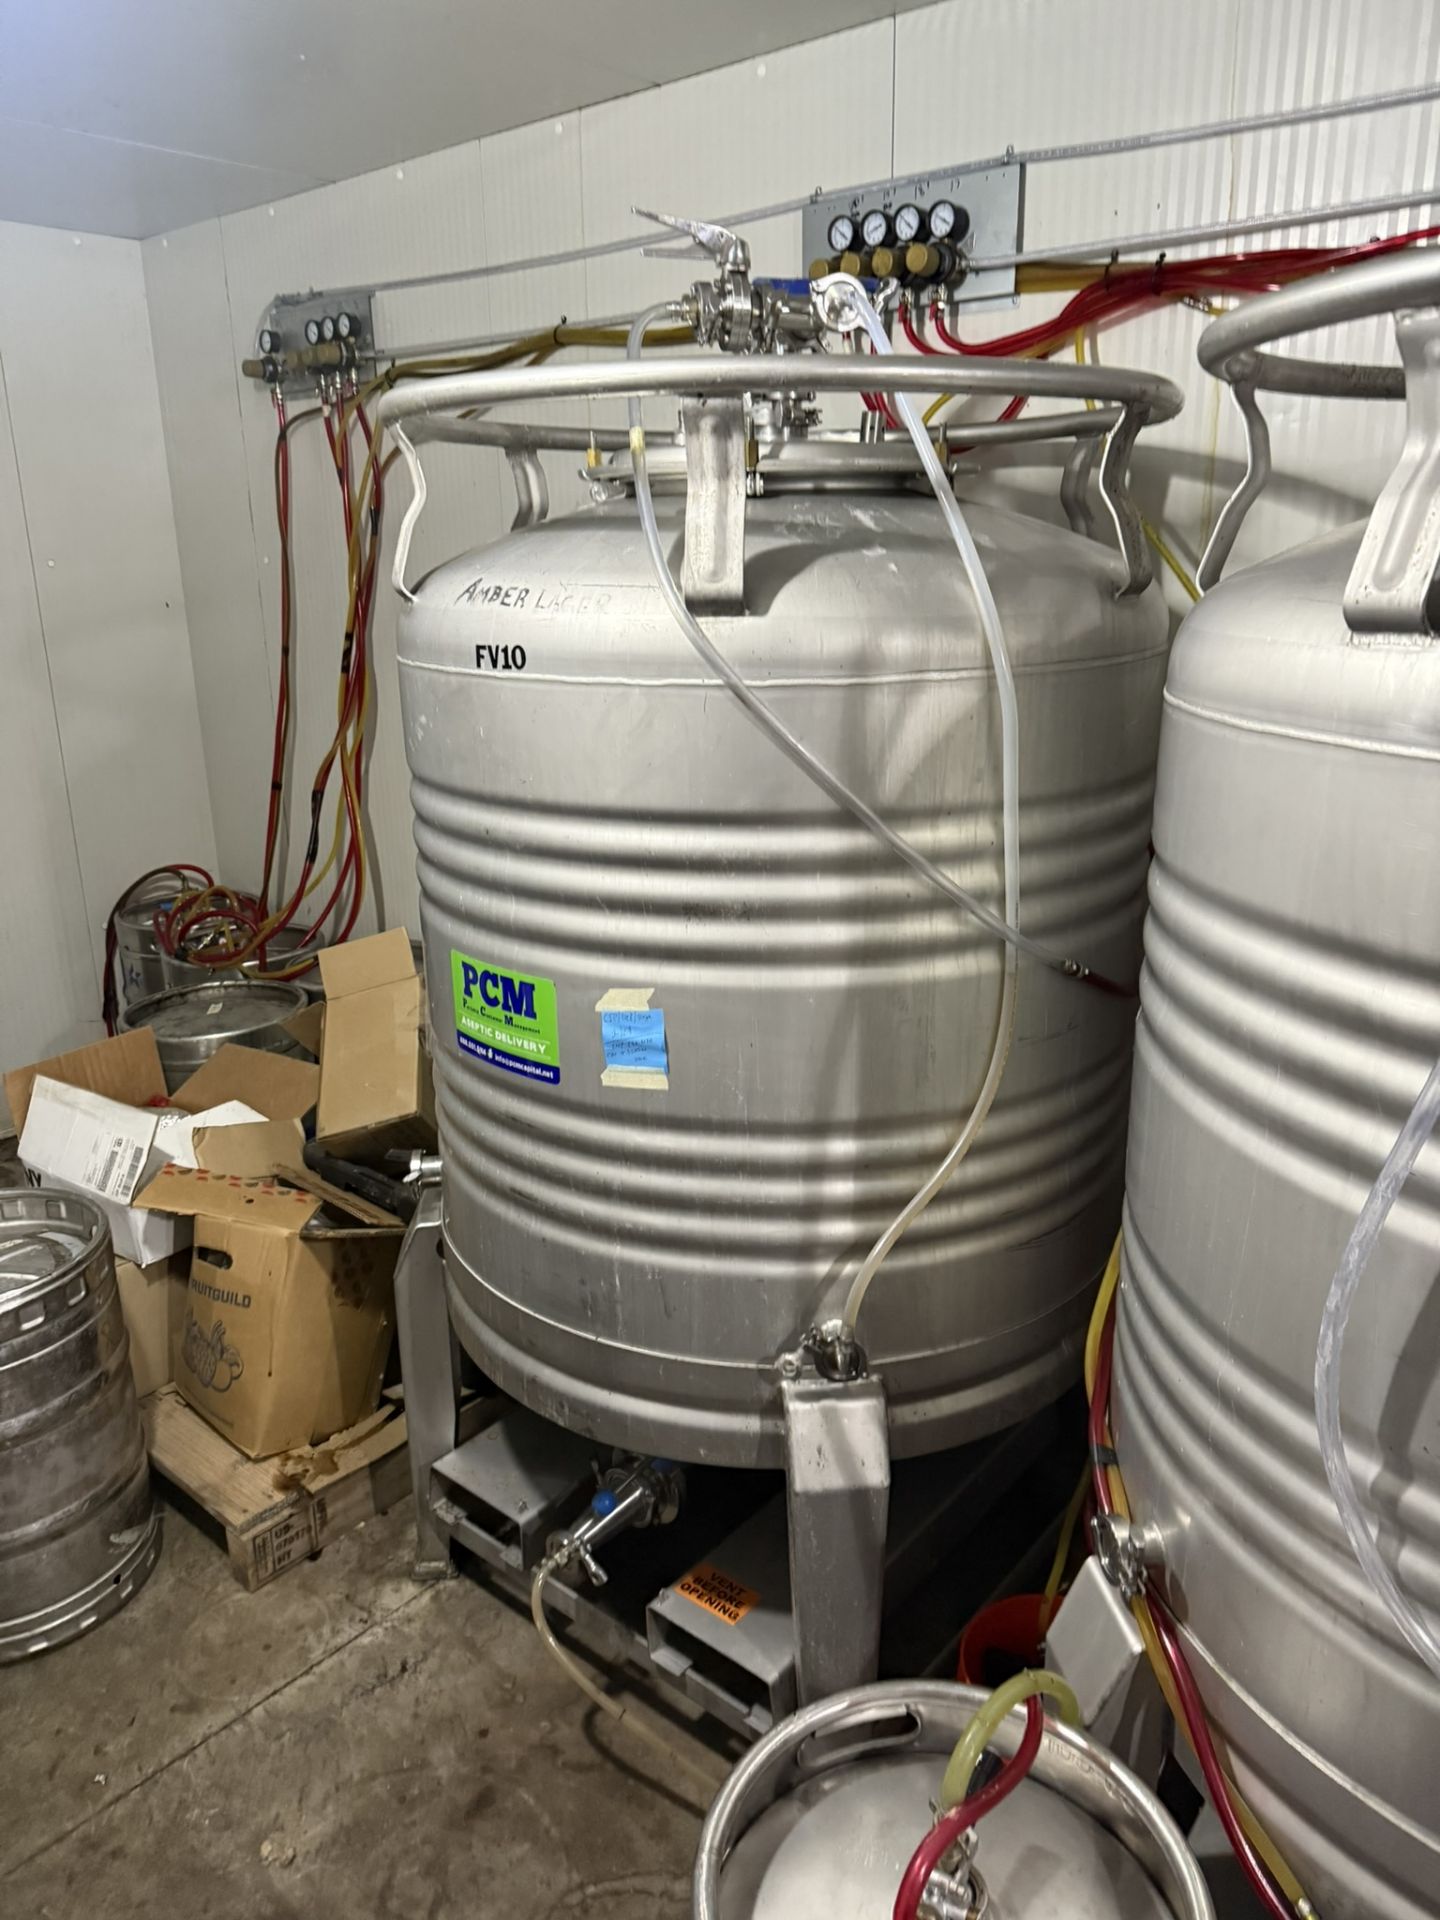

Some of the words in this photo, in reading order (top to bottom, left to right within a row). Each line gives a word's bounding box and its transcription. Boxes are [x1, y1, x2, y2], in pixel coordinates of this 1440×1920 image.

[455, 577, 530, 609] AMBER
[475, 644, 527, 671] FV10
[462, 960, 537, 1020] PCM
[461, 1016, 494, 1037] ASEPTIC
[495, 1030, 547, 1055] DELIVERY
[692, 1575, 746, 1609] BEFORE
[711, 1572, 747, 1596] VENT
[680, 1582, 740, 1621] OPENING
